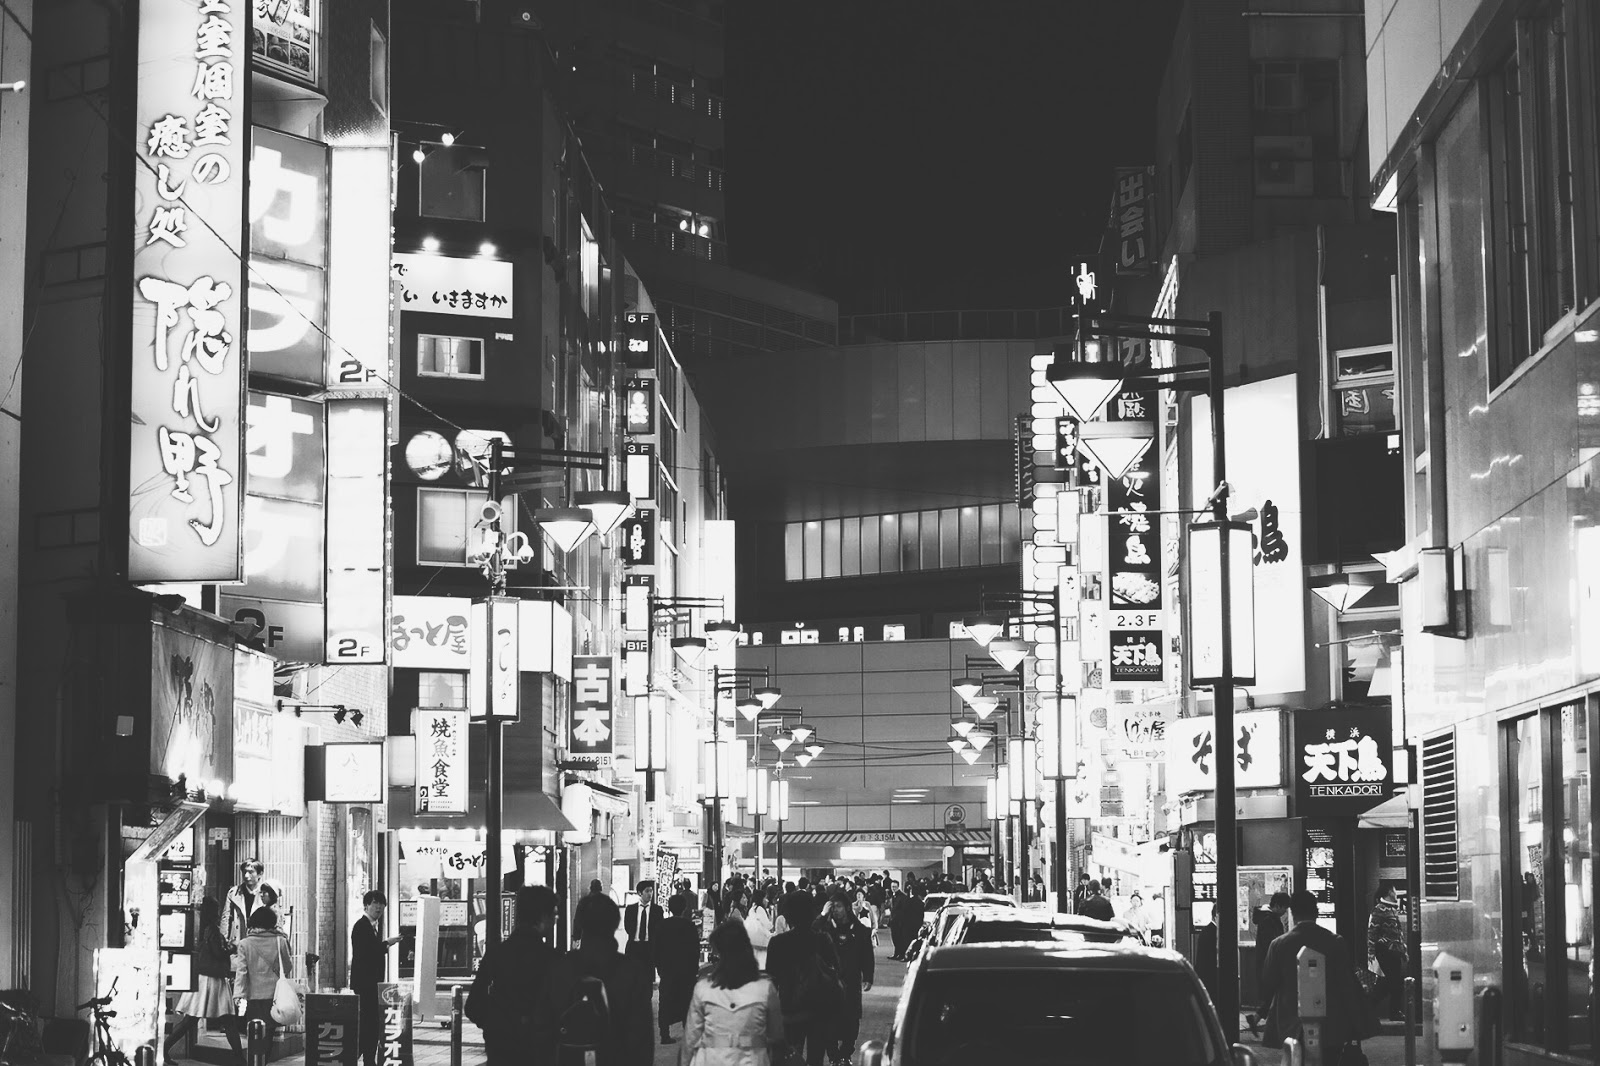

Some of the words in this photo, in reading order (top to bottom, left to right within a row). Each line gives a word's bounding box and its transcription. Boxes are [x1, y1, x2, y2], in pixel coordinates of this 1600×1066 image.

[1119, 173, 1146, 268] 出会い
[431, 288, 508, 310] いきますか
[339, 360, 377, 383] 2F
[338, 637, 370, 658] 2F
[572, 663, 611, 747] 古本
[430, 717, 451, 798] 焼魚食堂
[1310, 785, 1382, 796] TENKADORI
